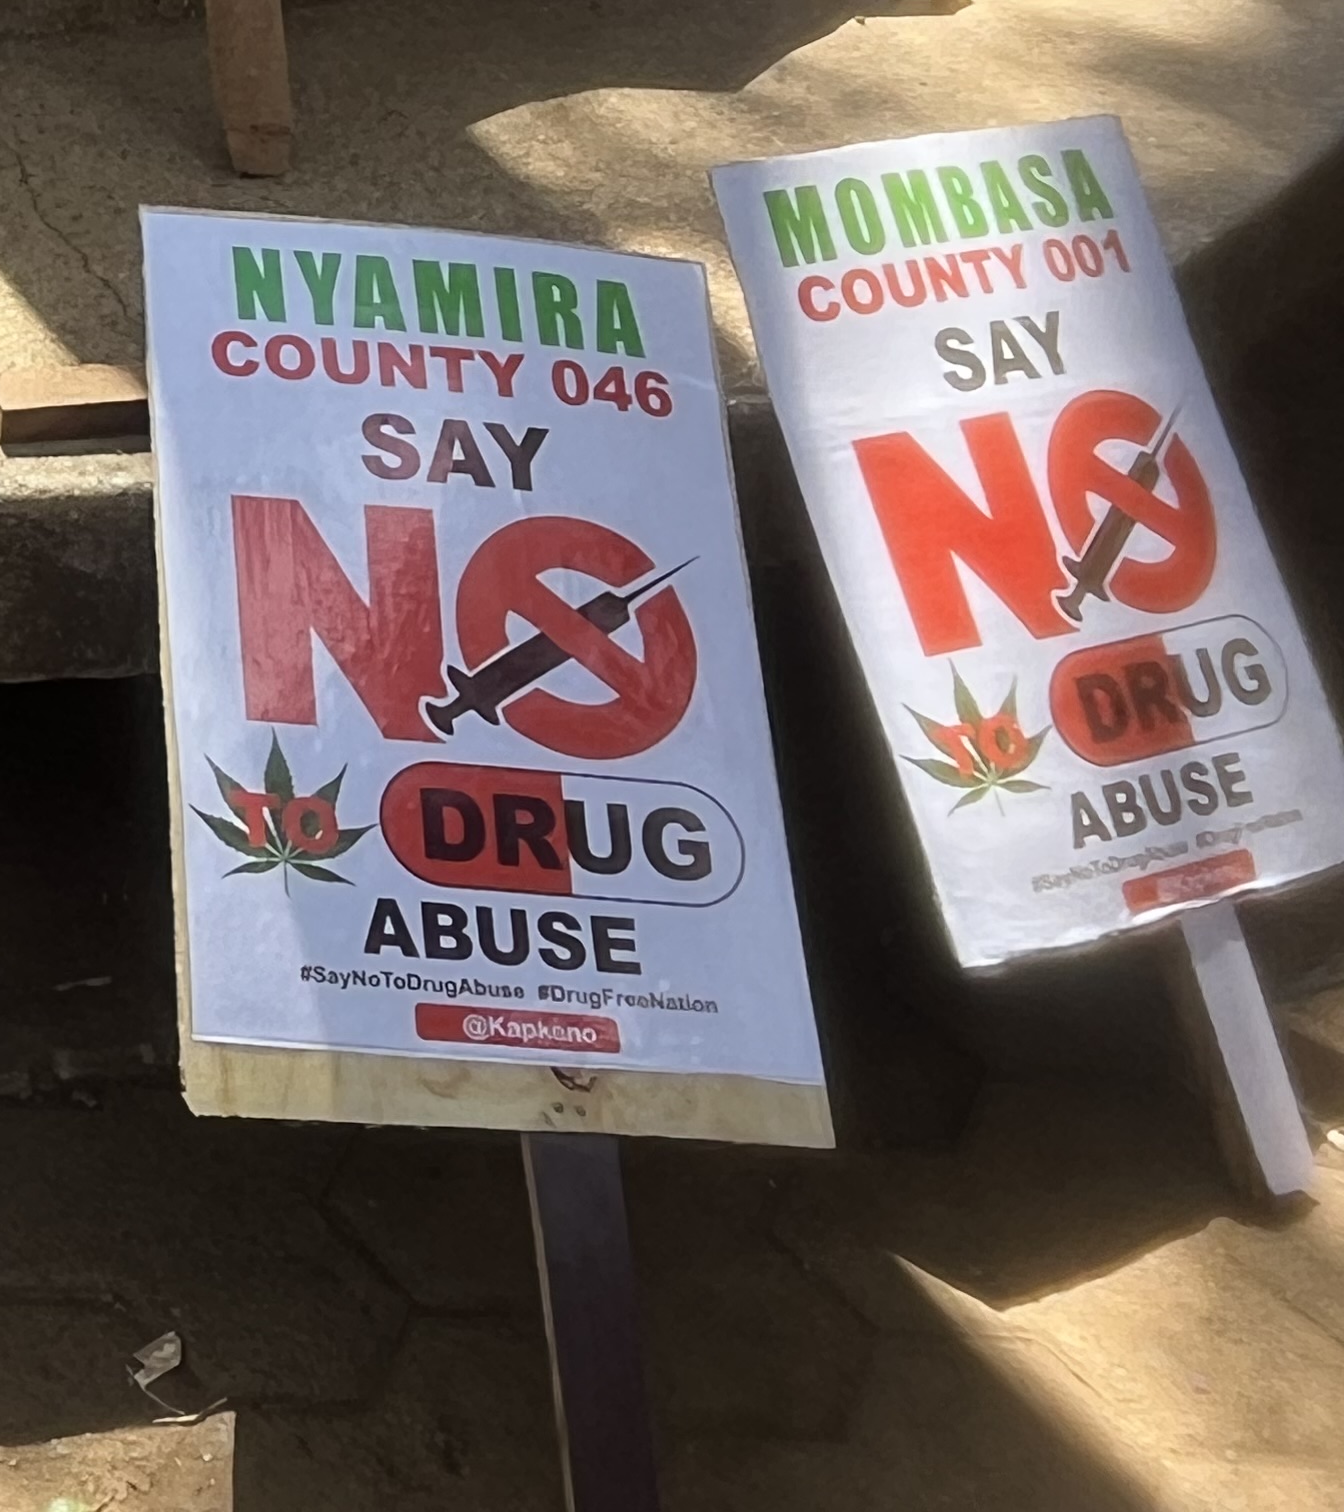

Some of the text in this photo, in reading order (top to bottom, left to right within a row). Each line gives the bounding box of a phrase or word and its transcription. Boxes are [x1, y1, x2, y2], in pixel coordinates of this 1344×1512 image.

[764, 149, 1112, 268] MOMBASA
[232, 246, 645, 358] NYAMIRA
[798, 230, 1132, 323] COUNTY 001
[211, 332, 674, 418] COUNTY 046
[934, 312, 1069, 392] SAY
[361, 411, 550, 493] SAY
[852, 390, 1218, 656] NO
[231, 494, 699, 760] NO
[936, 638, 1271, 777] TO DRUG
[231, 786, 713, 881] TO DRUG
[1068, 753, 1253, 849] ABUSE
[301, 965, 525, 999] #SayNoToDrugAbuse
[363, 898, 642, 975] ABUSE
